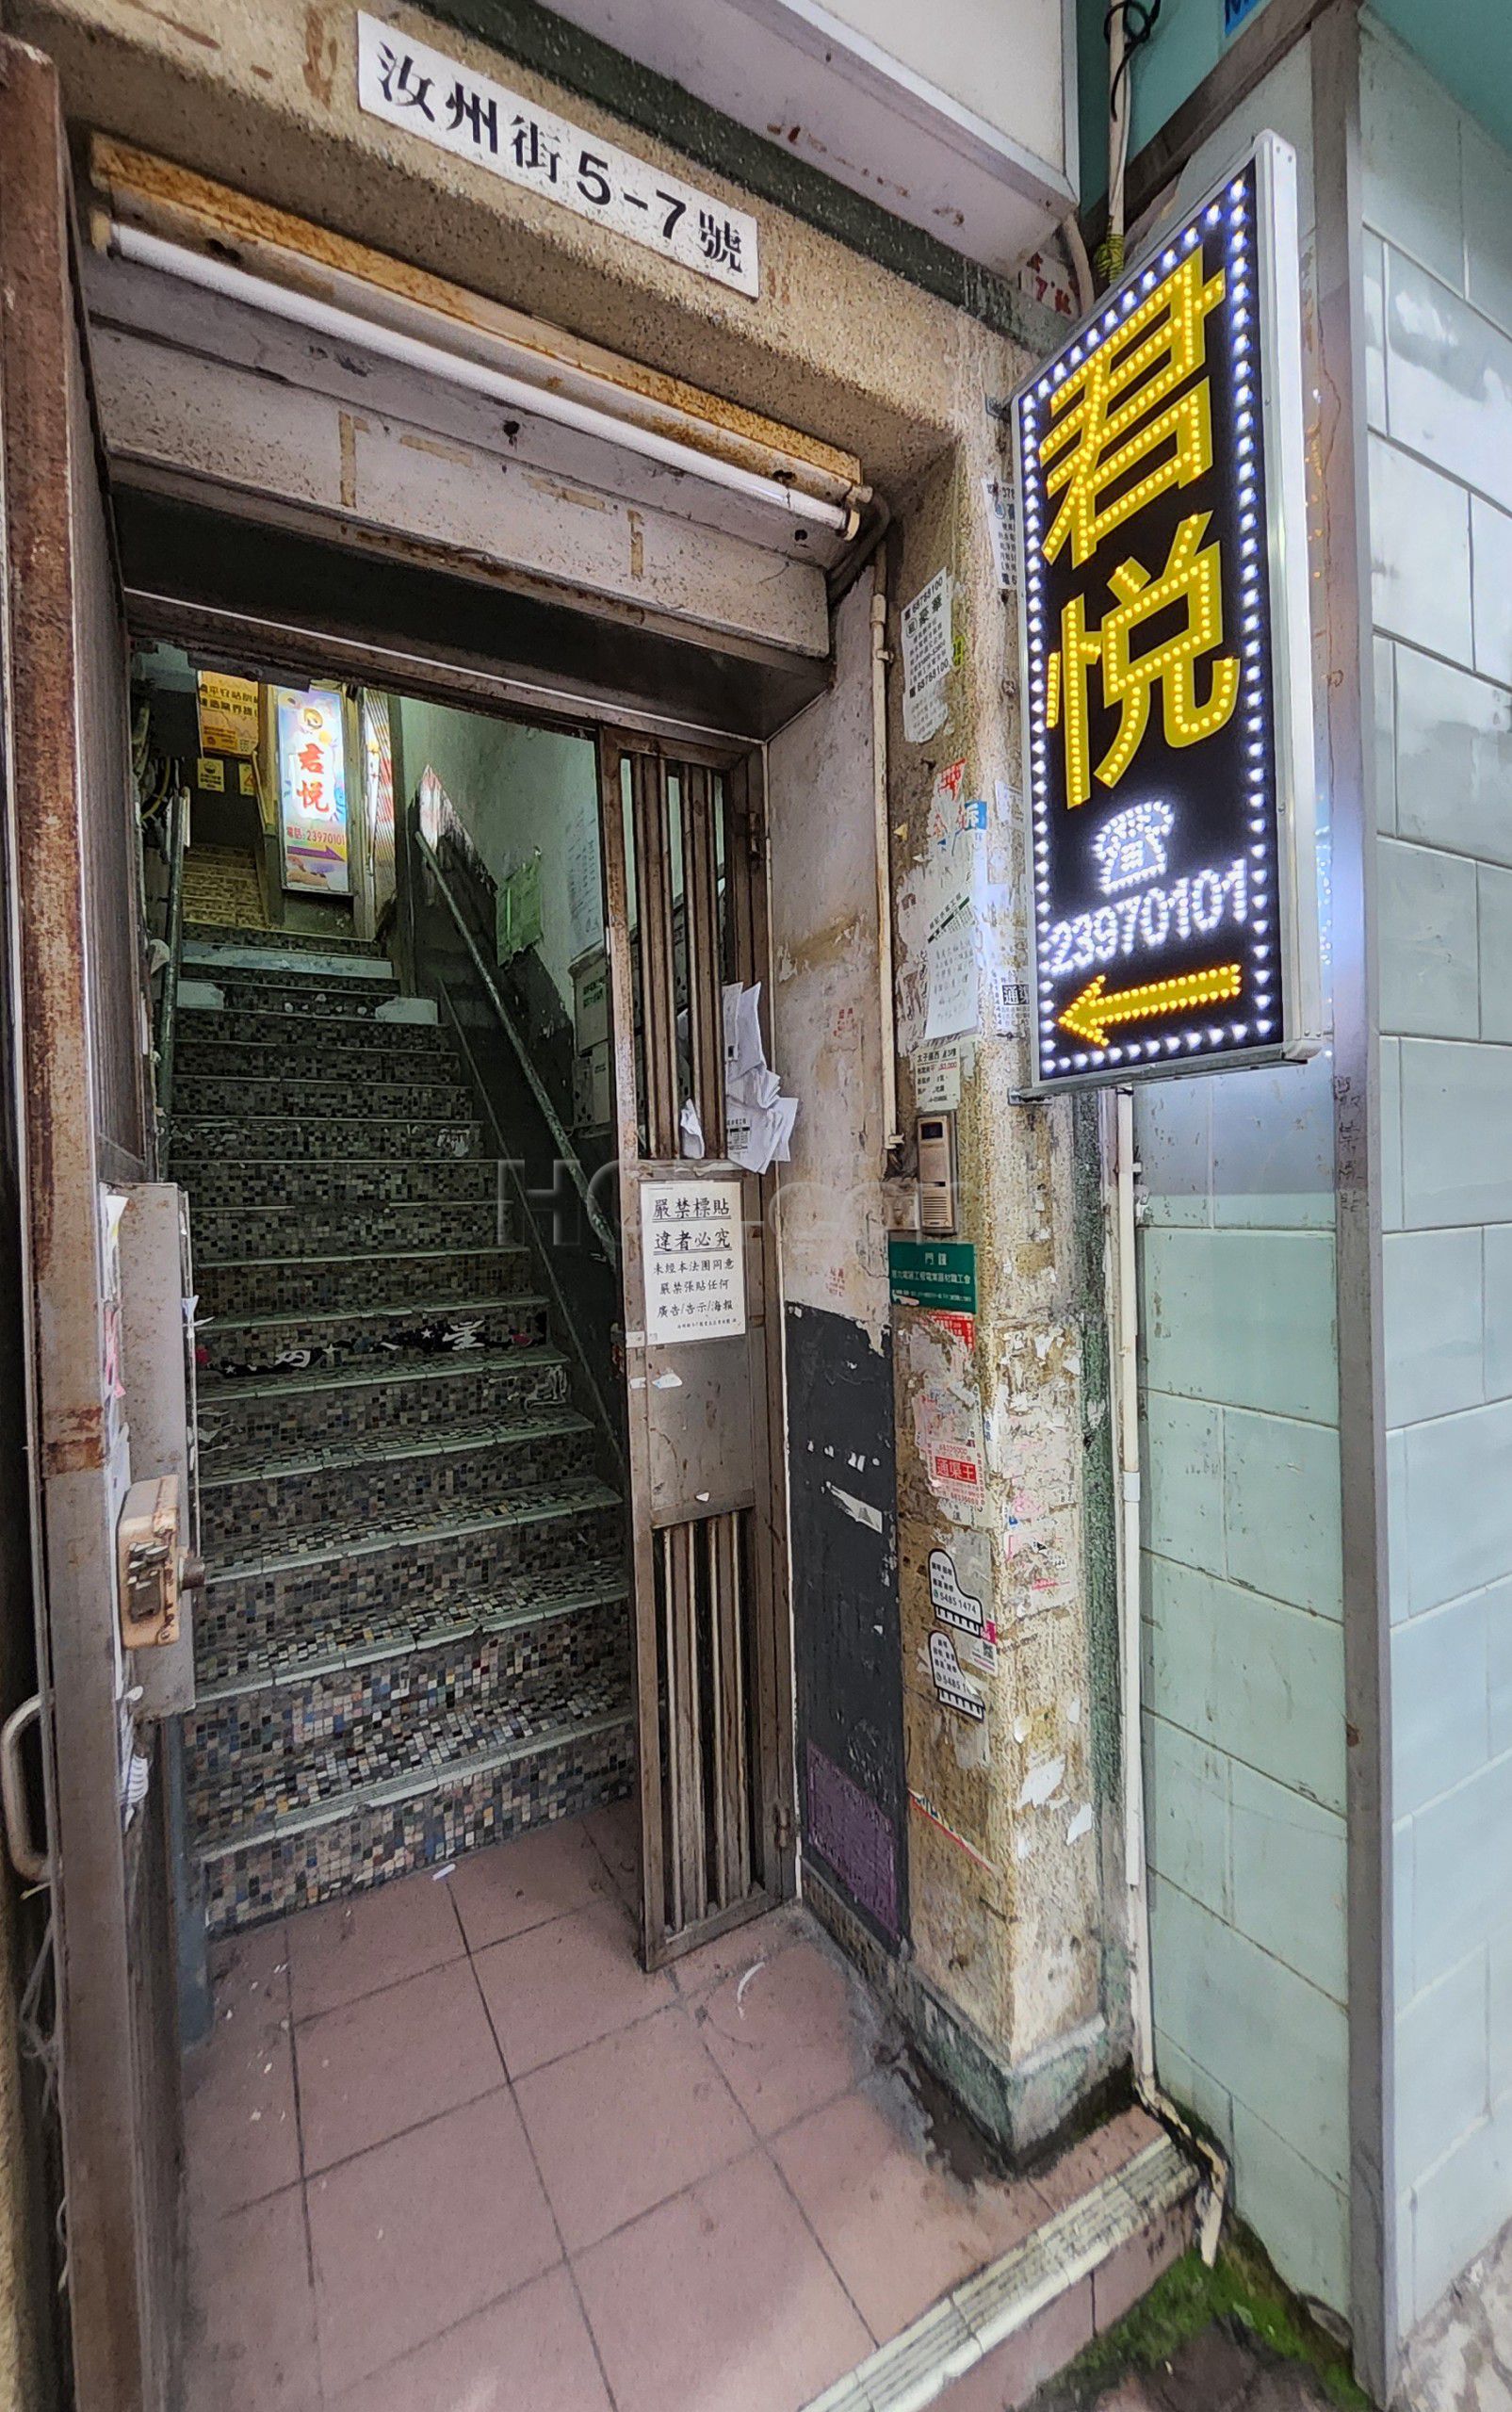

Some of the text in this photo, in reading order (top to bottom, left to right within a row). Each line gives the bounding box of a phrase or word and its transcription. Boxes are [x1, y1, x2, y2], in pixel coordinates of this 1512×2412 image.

[377, 41, 742, 274] 汝州街5-7號
[307, 830, 345, 845] 23970101
[1046, 858, 1248, 974] 23970101
[653, 1198, 730, 1218] 嚴禁標貼
[655, 1229, 732, 1251] 違者必究
[659, 1279, 729, 1296] 嚴禁張貼任何
[657, 1299, 734, 1319] 廣告/告示/海報
